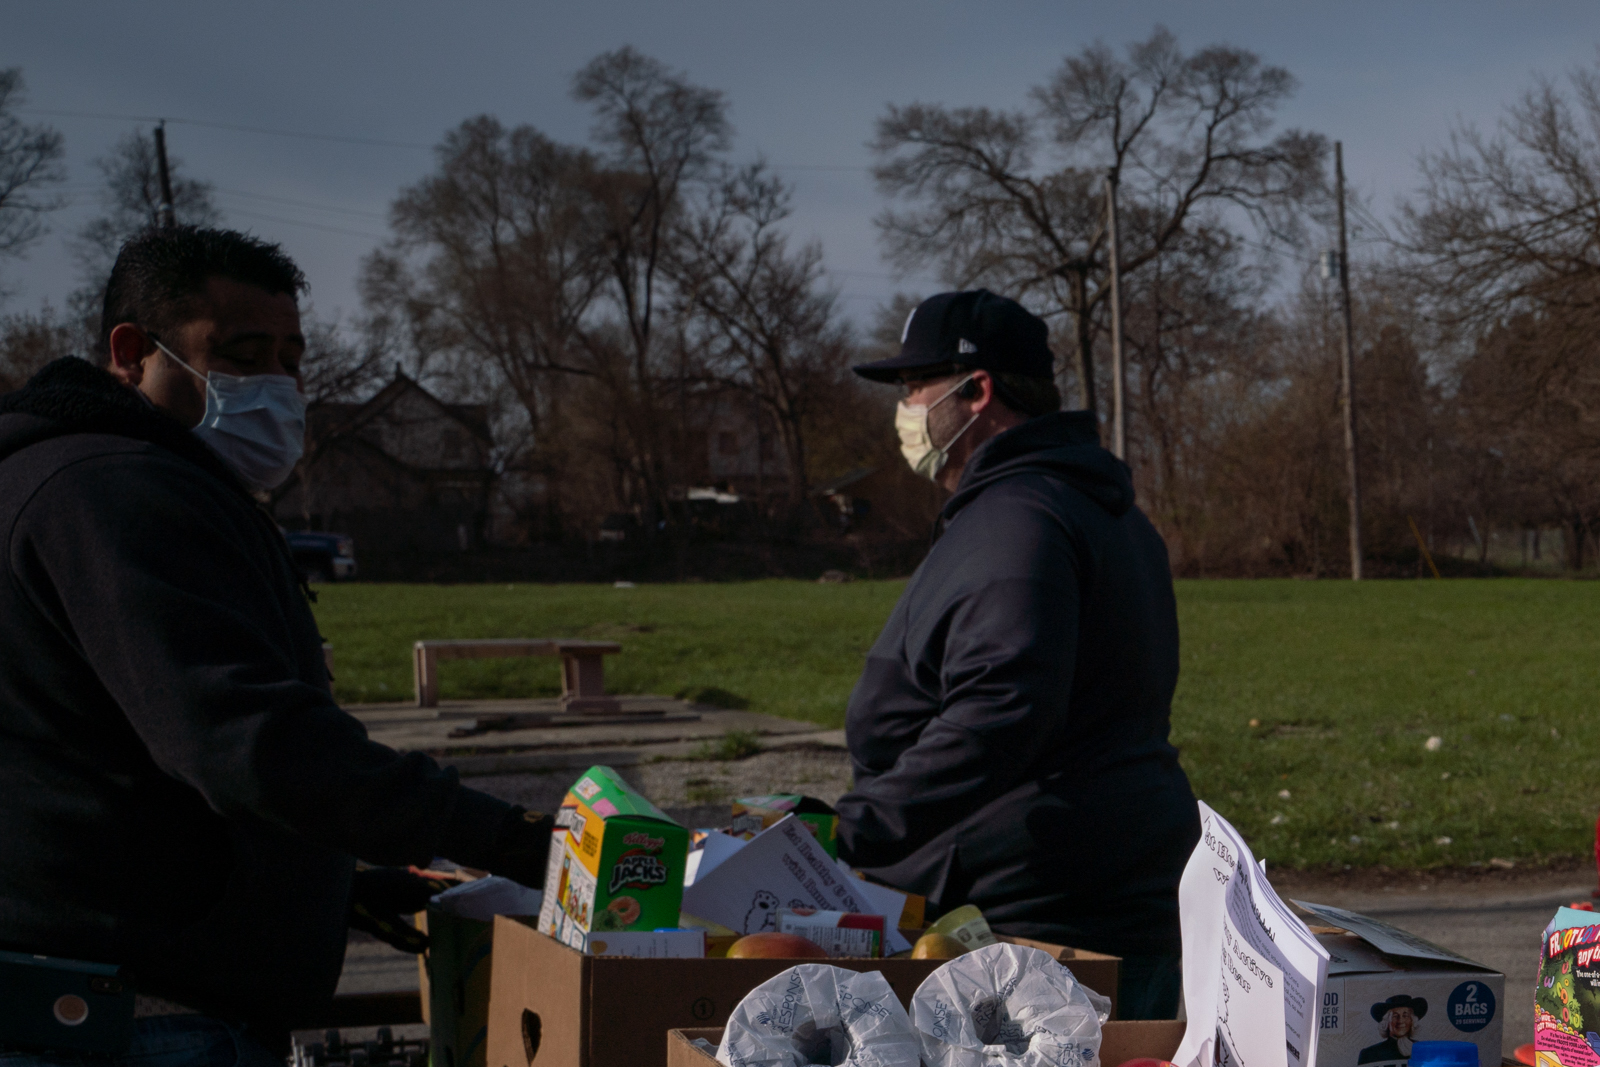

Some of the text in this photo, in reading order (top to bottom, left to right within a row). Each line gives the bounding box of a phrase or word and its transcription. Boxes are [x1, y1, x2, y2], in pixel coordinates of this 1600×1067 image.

[623, 830, 666, 848] Kellogg's
[622, 854, 659, 867] APPLE
[609, 859, 668, 895] JACKS
[1549, 928, 1579, 958] FROOT
[1233, 940, 1274, 989] Active
[1578, 949, 1593, 968] any
[1227, 960, 1252, 994] Bear
[1466, 984, 1478, 1002] 2
[1454, 1002, 1488, 1016] BAGS
[1462, 1017, 1486, 1025] SERVINGS
